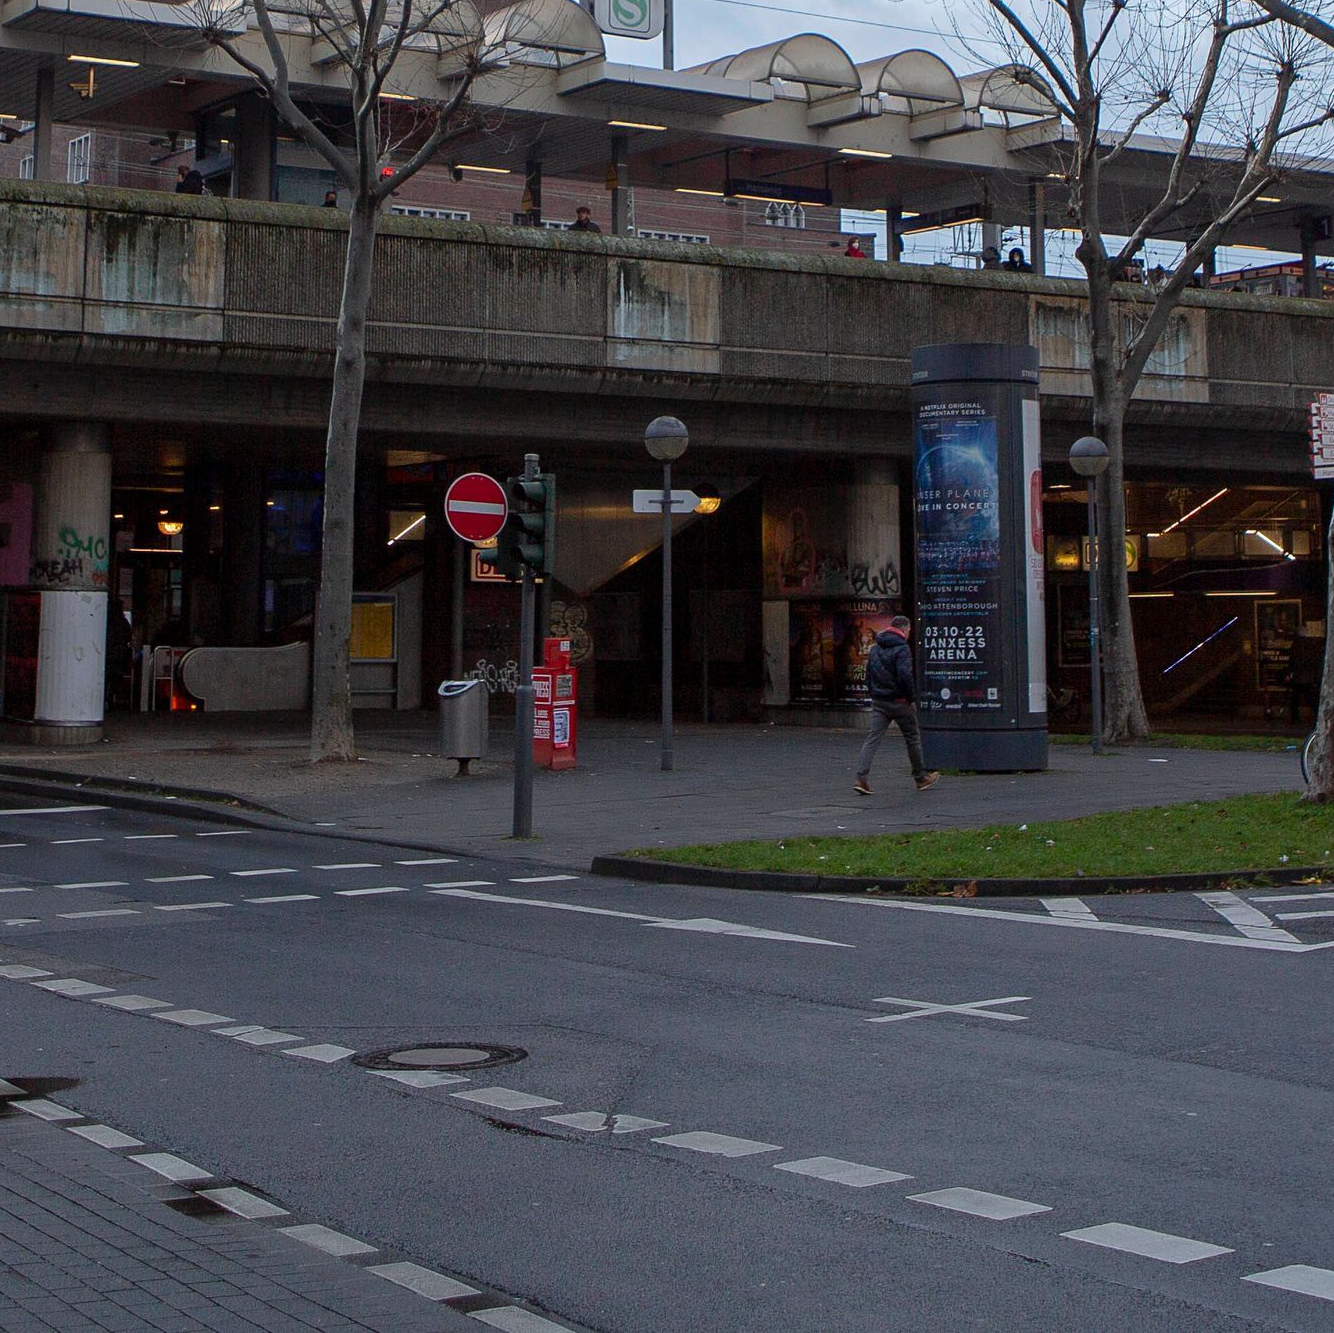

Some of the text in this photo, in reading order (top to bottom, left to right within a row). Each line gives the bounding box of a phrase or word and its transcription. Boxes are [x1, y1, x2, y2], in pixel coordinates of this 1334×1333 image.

[919, 410, 960, 418] DOCUMENTARY
[932, 503, 942, 511] IN
[946, 502, 997, 510] CONCERT
[954, 585, 979, 593] PRICE
[933, 602, 998, 610] ATTENBOROUGH
[924, 637, 986, 649] LANXESS
[929, 649, 978, 660] ARENA
